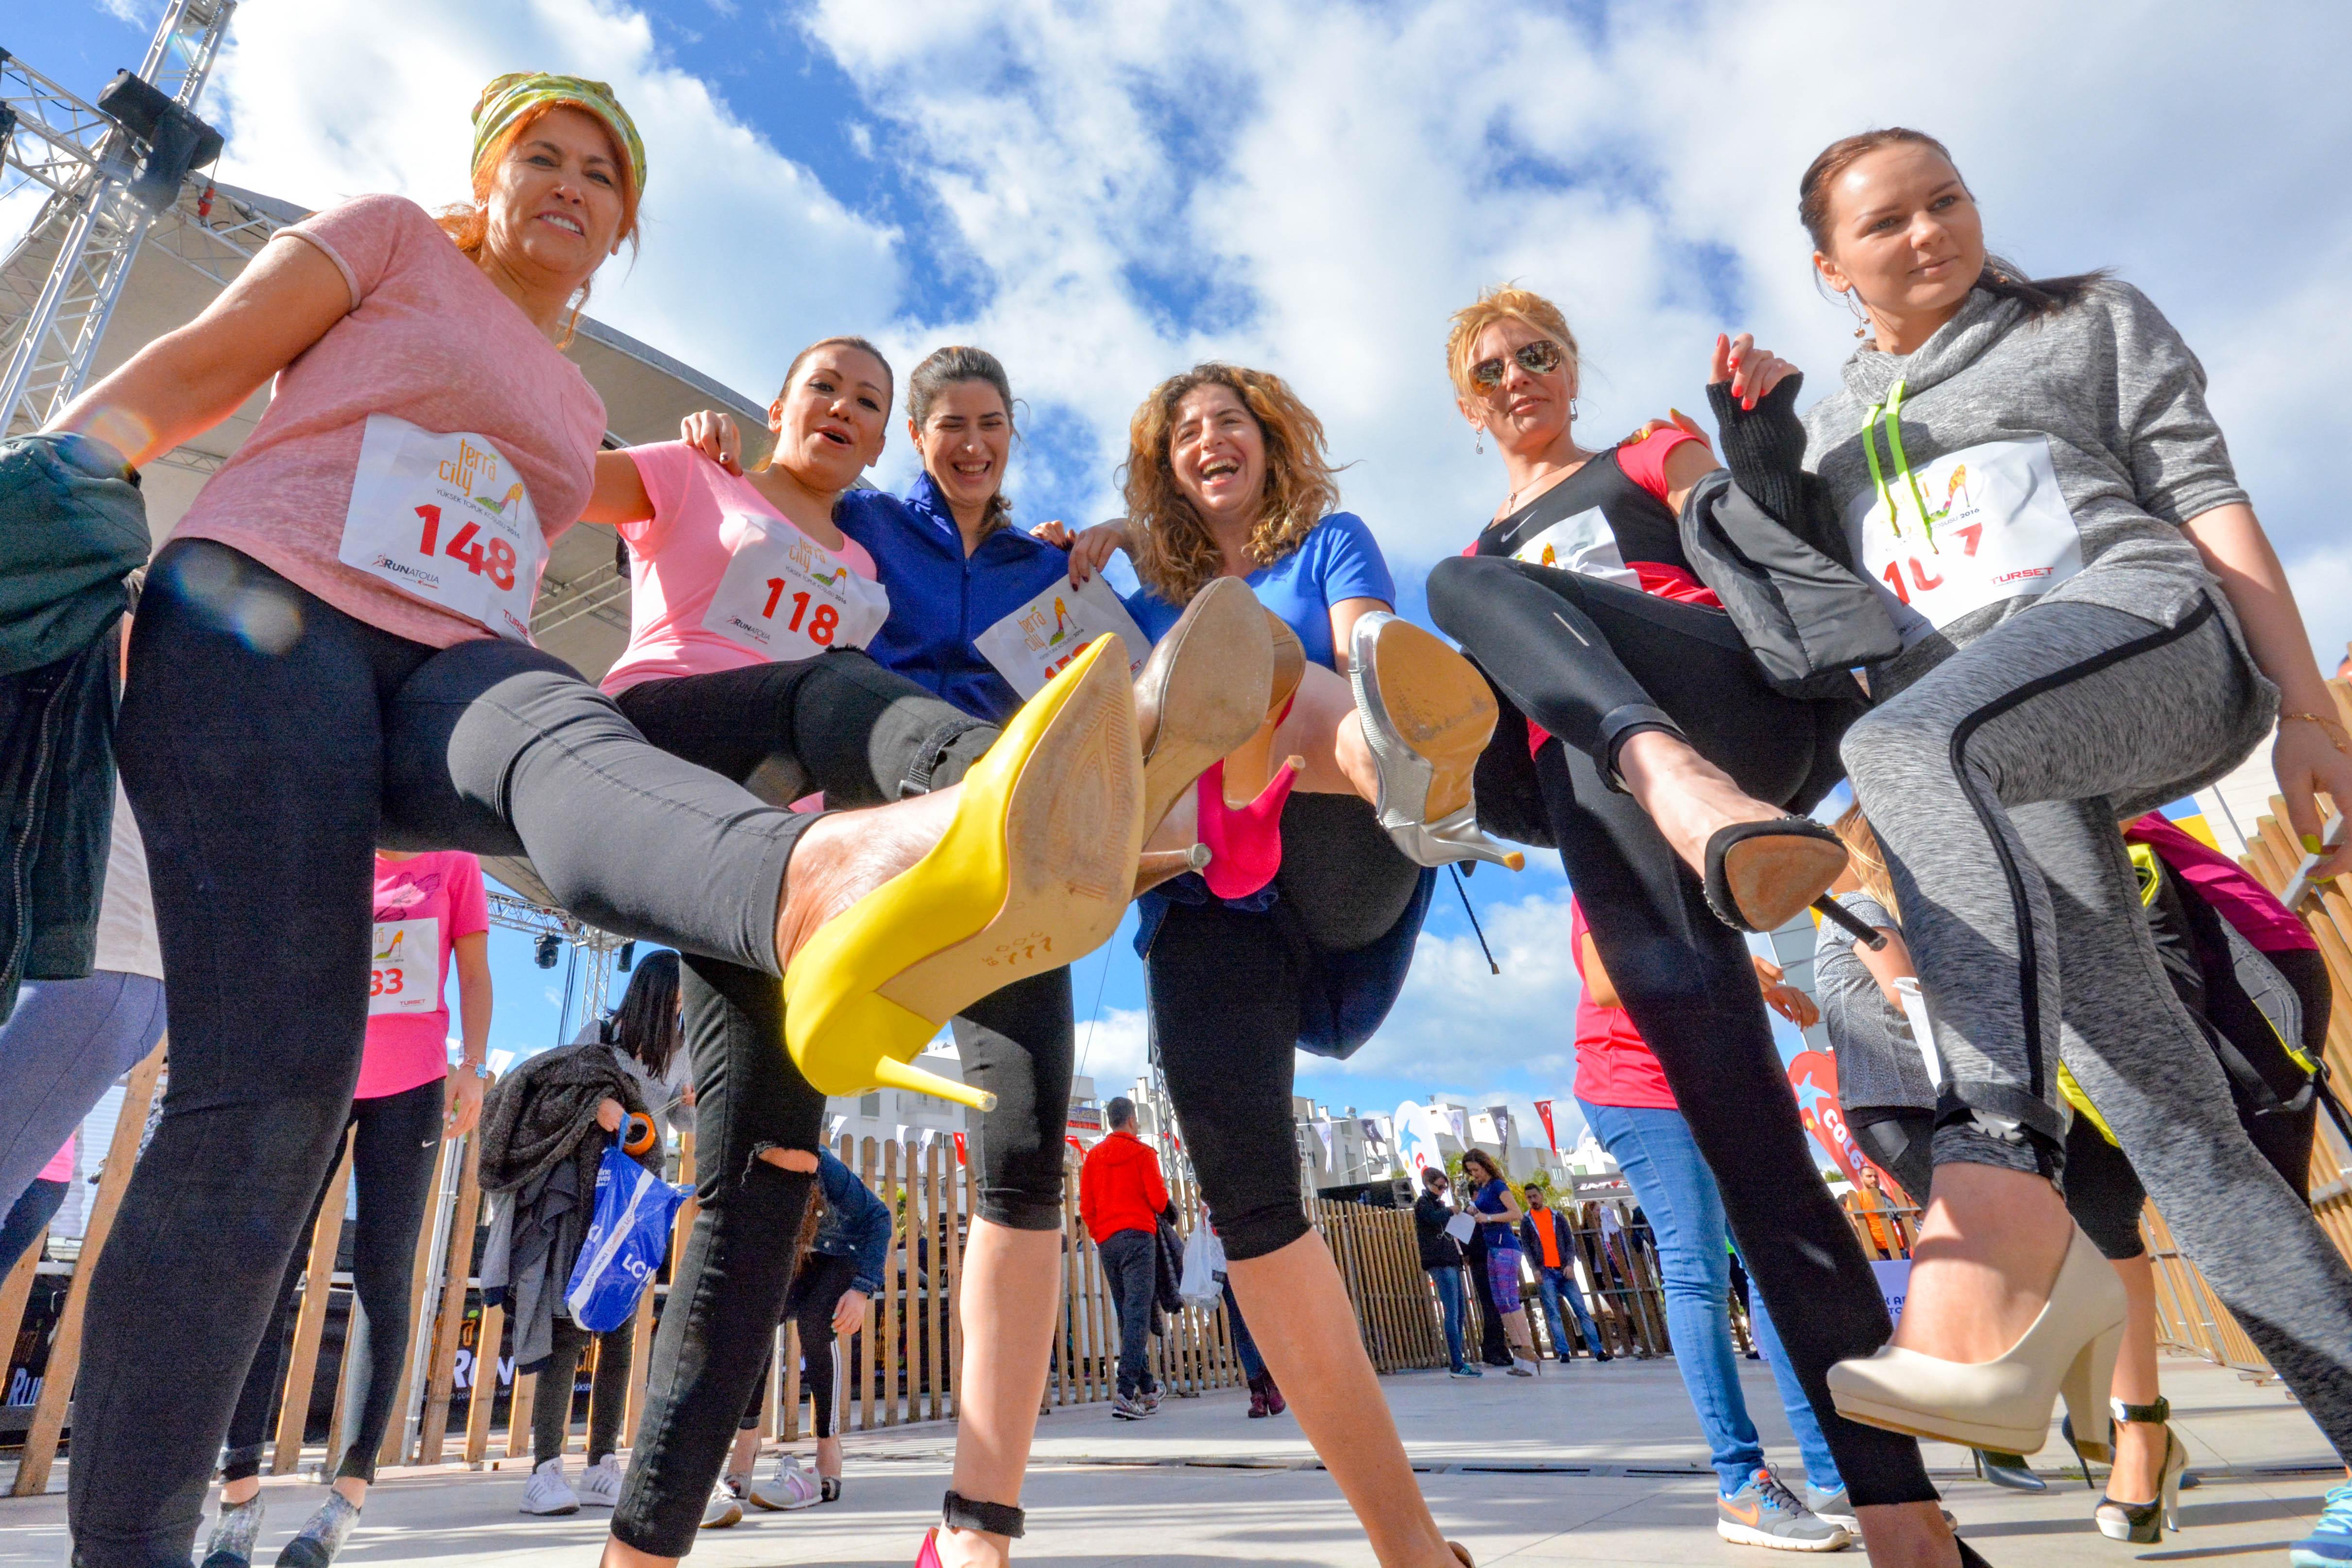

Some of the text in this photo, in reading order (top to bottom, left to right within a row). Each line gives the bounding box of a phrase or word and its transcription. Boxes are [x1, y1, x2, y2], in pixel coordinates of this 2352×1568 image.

[1960, 509, 1980, 519] 2016
[414, 504, 516, 591] 148
[384, 559, 439, 583] RUNATOLIA
[1990, 567, 2054, 584] TURSET
[835, 594, 847, 604] 2016
[762, 577, 839, 646] 118
